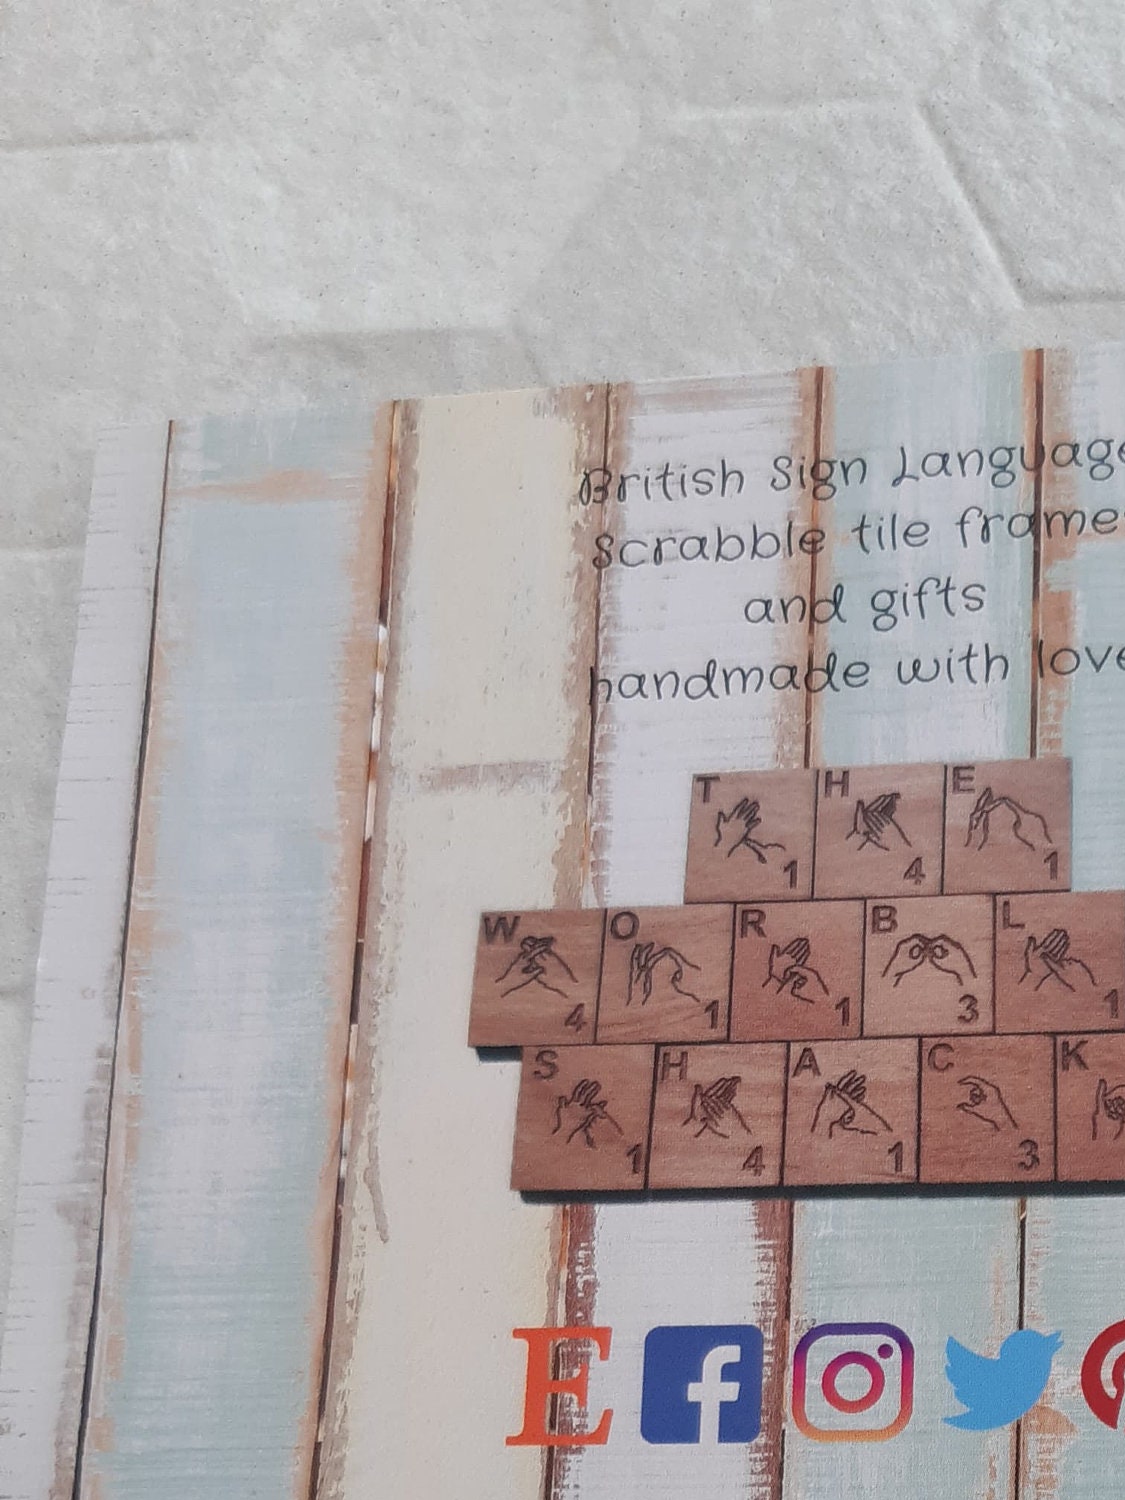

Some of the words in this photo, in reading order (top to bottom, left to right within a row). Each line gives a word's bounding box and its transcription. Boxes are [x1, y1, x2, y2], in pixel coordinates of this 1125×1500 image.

[579, 459, 745, 507] British
[770, 453, 868, 500] Sign
[852, 516, 930, 554] tile
[745, 582, 846, 625] and
[871, 576, 987, 632] gifts
[589, 658, 870, 705] handmade
[897, 643, 1009, 687] with
[696, 775, 720, 804] T
[824, 770, 850, 797] H
[952, 766, 976, 793] E
[783, 861, 798, 889] 1
[904, 857, 925, 886] 4
[1044, 851, 1060, 880] 1
[482, 915, 520, 942] W
[610, 912, 639, 941] O
[739, 909, 767, 937] R
[872, 905, 898, 933] B
[1002, 903, 1025, 930] L
[564, 1004, 587, 1033] 4
[705, 1001, 720, 1029] 1
[835, 997, 851, 1026] 1
[958, 995, 979, 1023] 3
[1104, 989, 1119, 1019] 1
[533, 1050, 558, 1079] S
[659, 1052, 687, 1080] H
[793, 1048, 821, 1076] A
[928, 1043, 955, 1072] C
[1062, 1041, 1088, 1070] K
[627, 1145, 643, 1174] 1
[743, 1146, 765, 1175] 4
[888, 1142, 904, 1172] 1
[1018, 1140, 1040, 1168] 3
[505, 1326, 613, 1446] E
[688, 1345, 741, 1443] f
